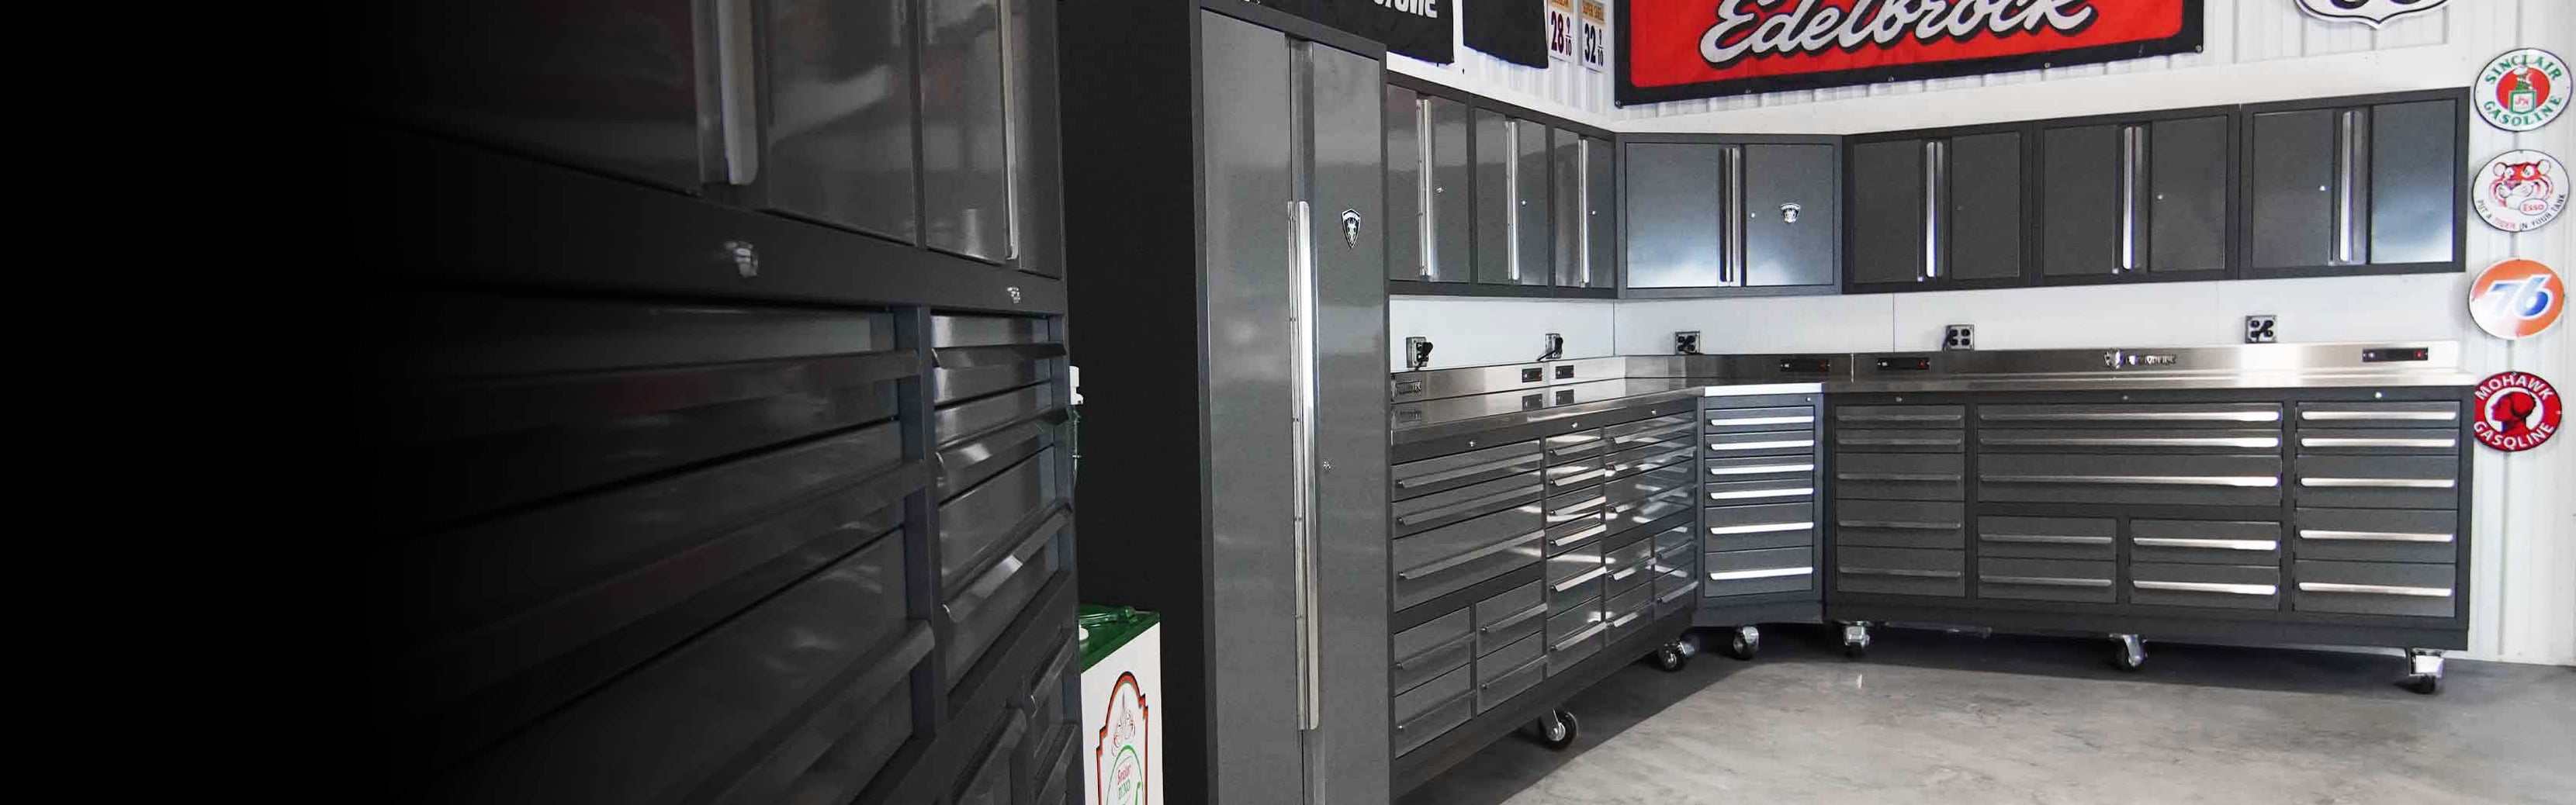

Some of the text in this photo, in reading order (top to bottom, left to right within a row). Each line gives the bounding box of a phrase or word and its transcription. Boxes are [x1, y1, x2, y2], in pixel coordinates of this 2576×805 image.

[1551, 11, 1564, 54] 28
[1584, 22, 1596, 64] 32
[2485, 54, 2562, 84] SINCLAIR
[2484, 95, 2562, 126] GASOLINE
[2489, 276, 2550, 318] 76
[2475, 375, 2553, 401] MOHAWK
[2474, 421, 2554, 451] GASOLINE
